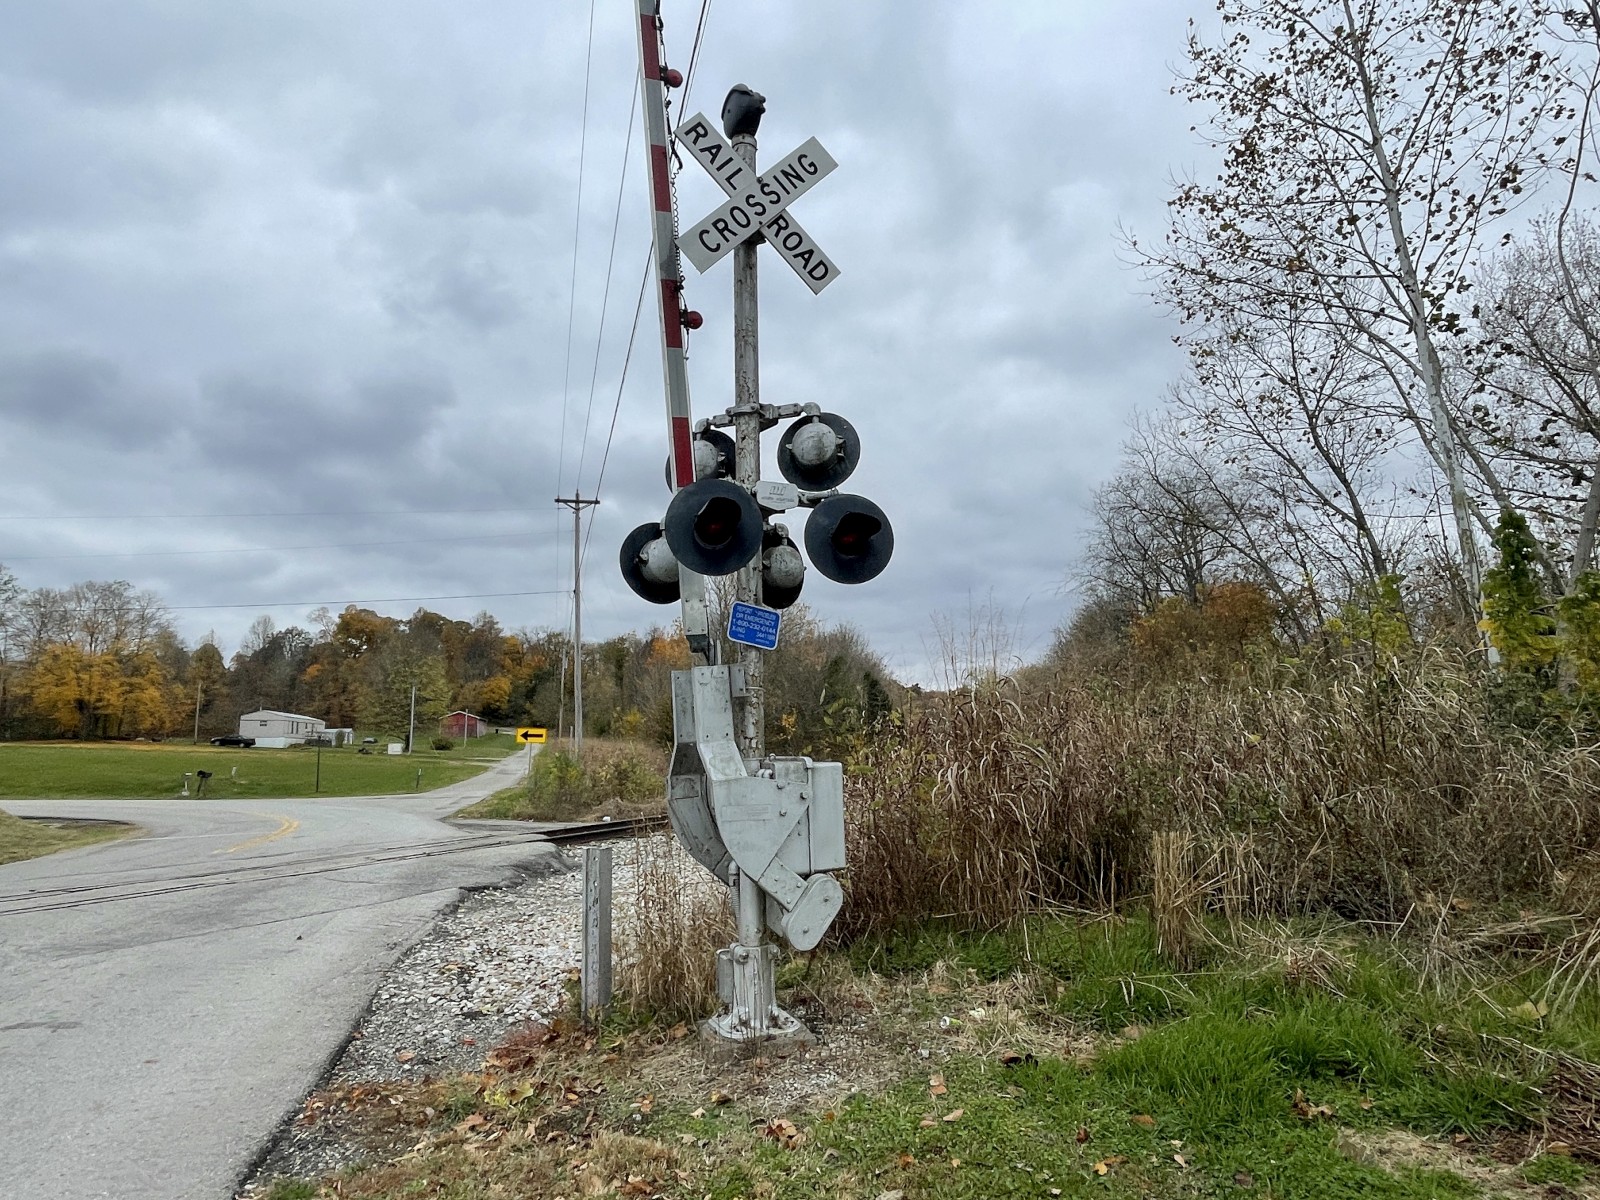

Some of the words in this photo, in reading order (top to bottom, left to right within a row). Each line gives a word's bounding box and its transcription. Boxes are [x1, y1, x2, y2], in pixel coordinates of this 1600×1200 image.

[684, 122, 743, 190] RAIL
[699, 153, 818, 252] CROSSING
[767, 214, 829, 281] ROAD
